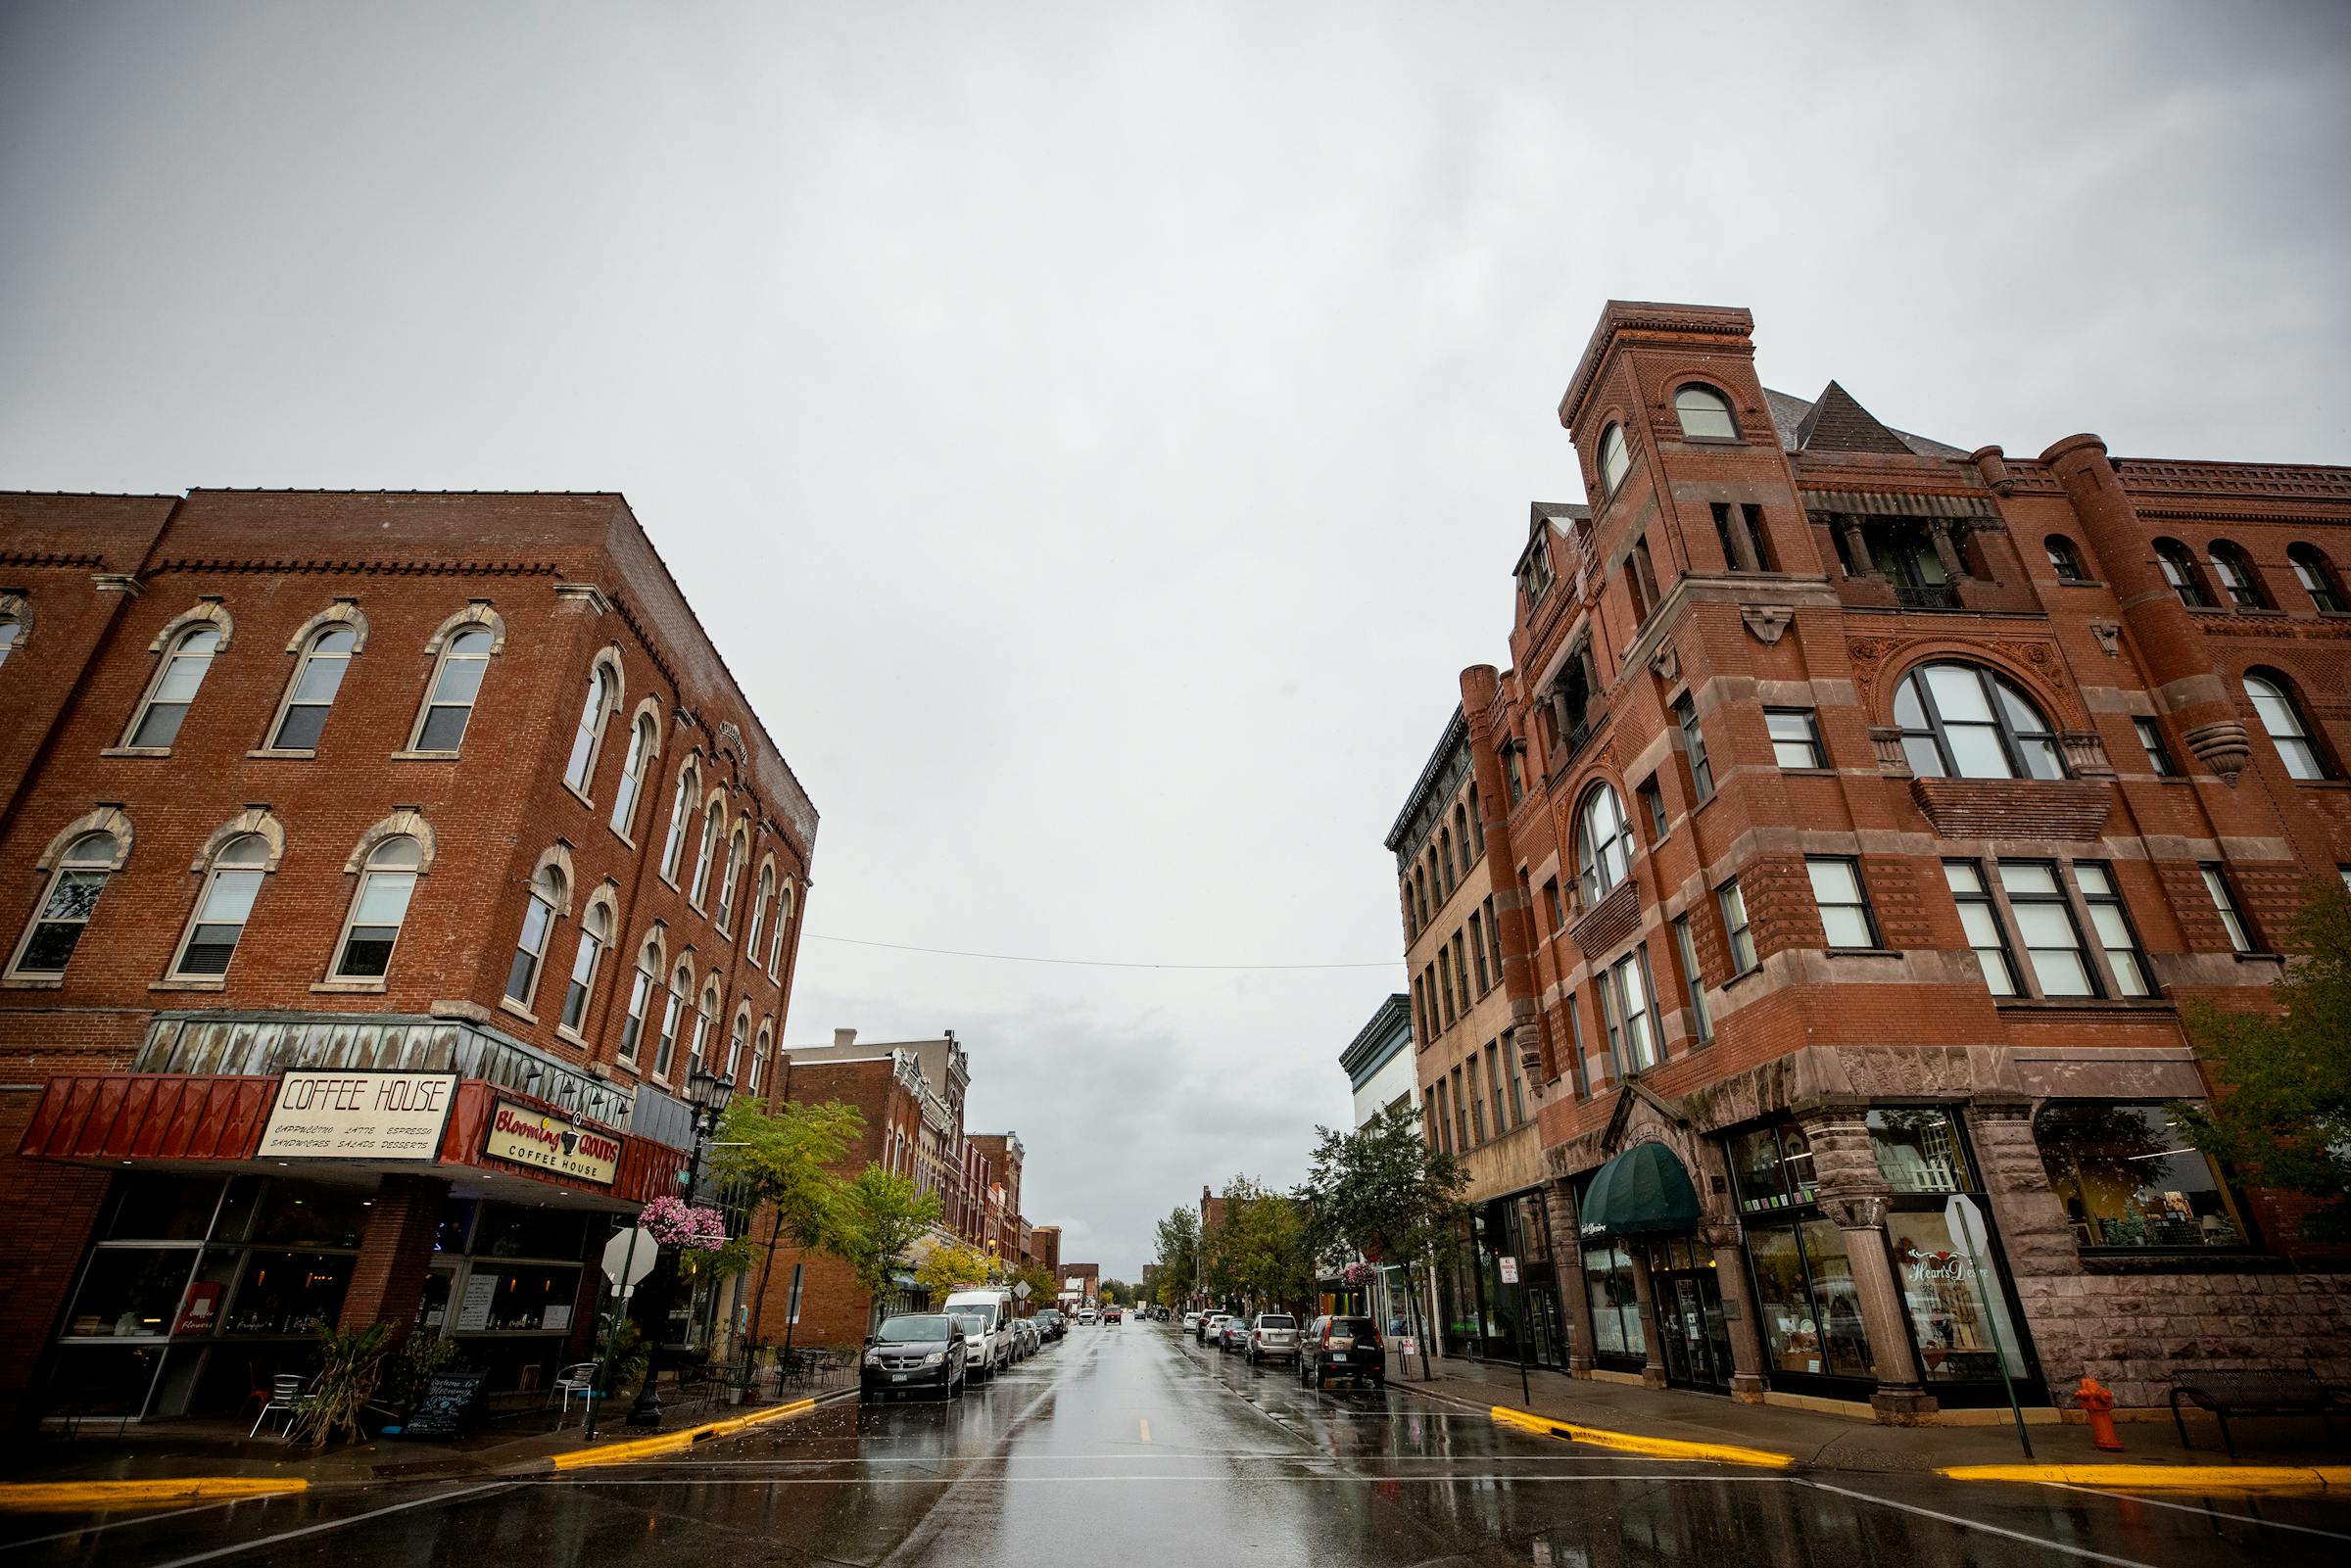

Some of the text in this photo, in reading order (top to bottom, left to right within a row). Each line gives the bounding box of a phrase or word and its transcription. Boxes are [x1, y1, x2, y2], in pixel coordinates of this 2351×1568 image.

[282, 1079, 448, 1112] COFFEE HOUSE
[274, 1125, 433, 1136] CAPPUCCINO LATTE ESPRESSO
[496, 1110, 561, 1153] Blooming
[270, 1139, 428, 1150] SANDWICHES SALADS DESSERTS
[509, 1145, 598, 1176] COFFEE HOUSE
[1908, 1259, 1990, 1282] Heart's Desre
